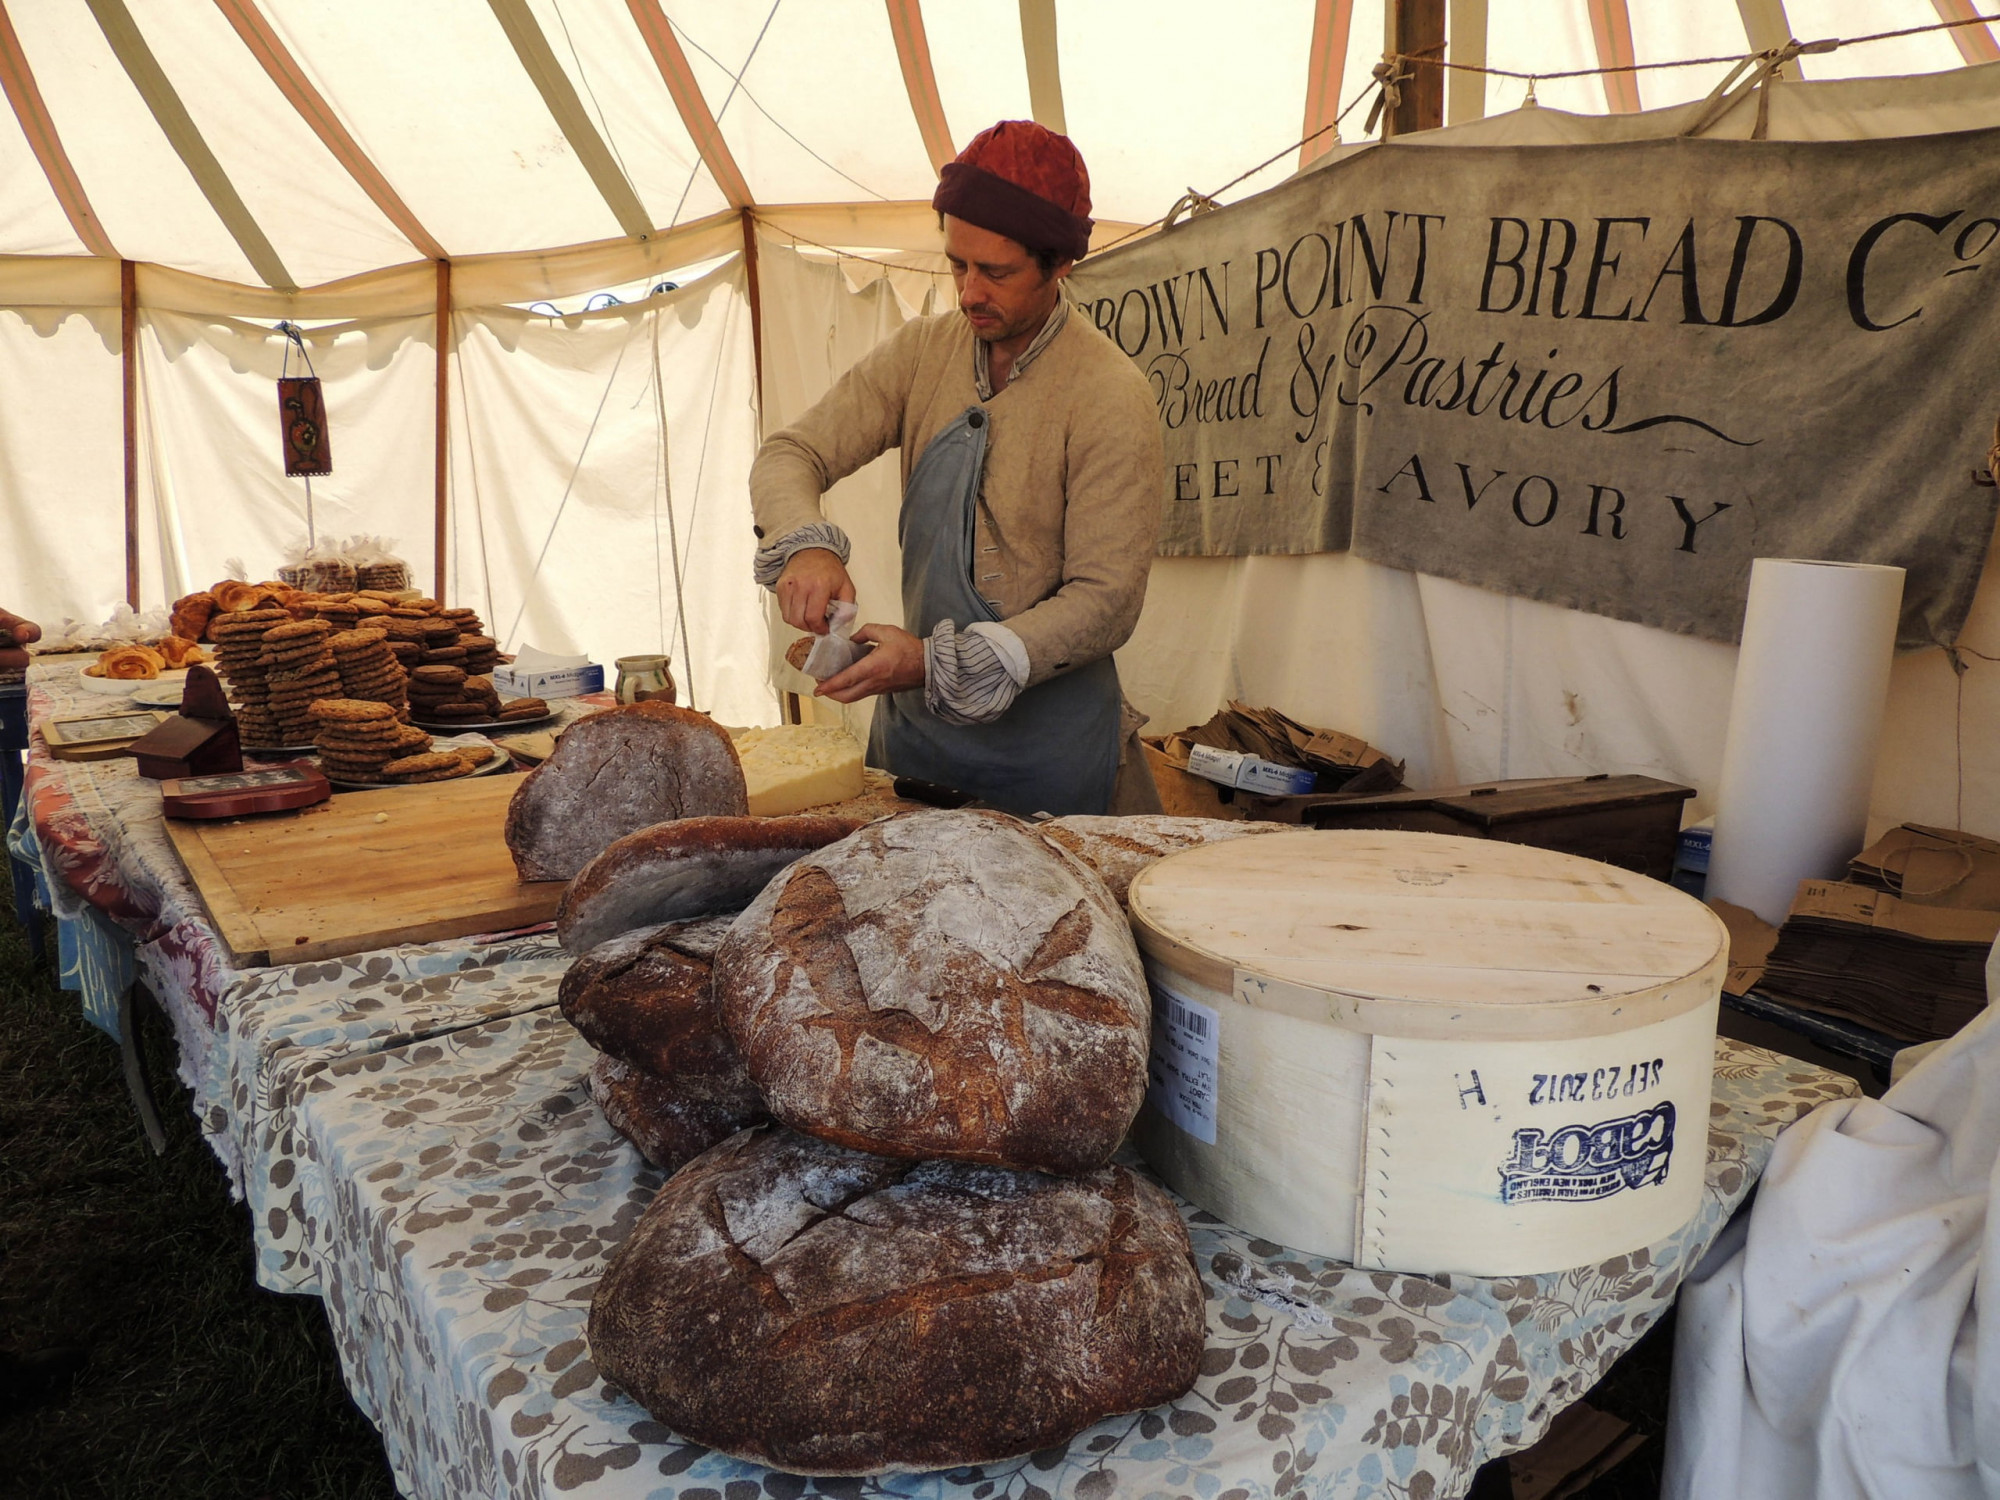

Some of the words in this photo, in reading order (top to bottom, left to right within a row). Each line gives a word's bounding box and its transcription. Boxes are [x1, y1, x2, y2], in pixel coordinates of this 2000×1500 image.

[1254, 210, 1446, 329] POINT
[1476, 214, 1804, 328] BREAD
[1146, 336, 1272, 429] Bread
[1289, 322, 1336, 443] &
[1338, 305, 1625, 432] Pastries
[1173, 453, 1282, 502] EET
[1376, 452, 1734, 555] AVORY
[1181, 1072, 1199, 1086] EXTRA
[1592, 1066, 1621, 1101] 23
[1623, 1058, 1664, 1098] SEP
[1189, 1086, 1211, 1102] CABOT
[1529, 1072, 1588, 1106] 2012
[1510, 1178, 1551, 1191] ENGLAND
[1552, 1178, 1570, 1187] NEW
[1578, 1178, 1597, 1187] YORK
[1600, 1173, 1616, 1186] NEW
[1517, 1188, 1556, 1199] FAMILIES
[1557, 1189, 1578, 1197] FARM
